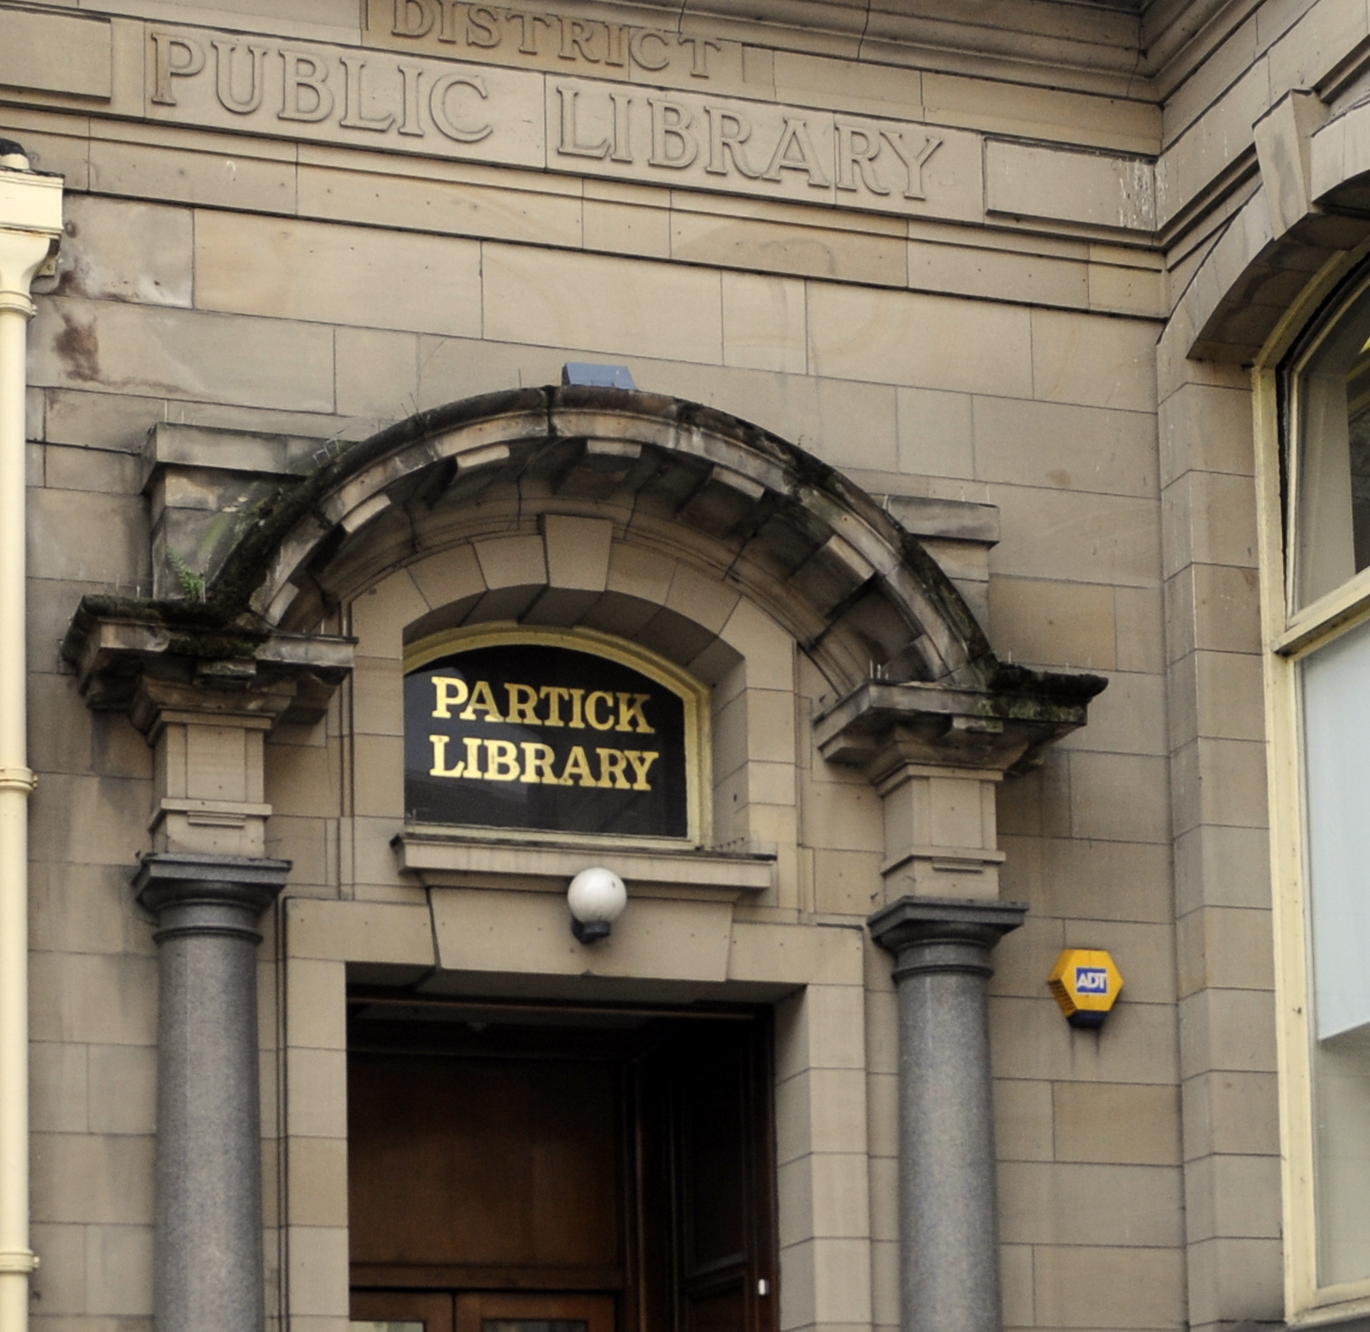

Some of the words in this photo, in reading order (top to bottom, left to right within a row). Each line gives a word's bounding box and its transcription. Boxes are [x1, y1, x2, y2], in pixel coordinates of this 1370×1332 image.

[391, 0, 721, 78] DISTRICT
[150, 31, 494, 143] PUBLIC
[556, 85, 943, 201] LIBRARY
[431, 675, 656, 734] PARTICK
[429, 734, 659, 791] LIBRARY
[1076, 972, 1108, 989] ADT
